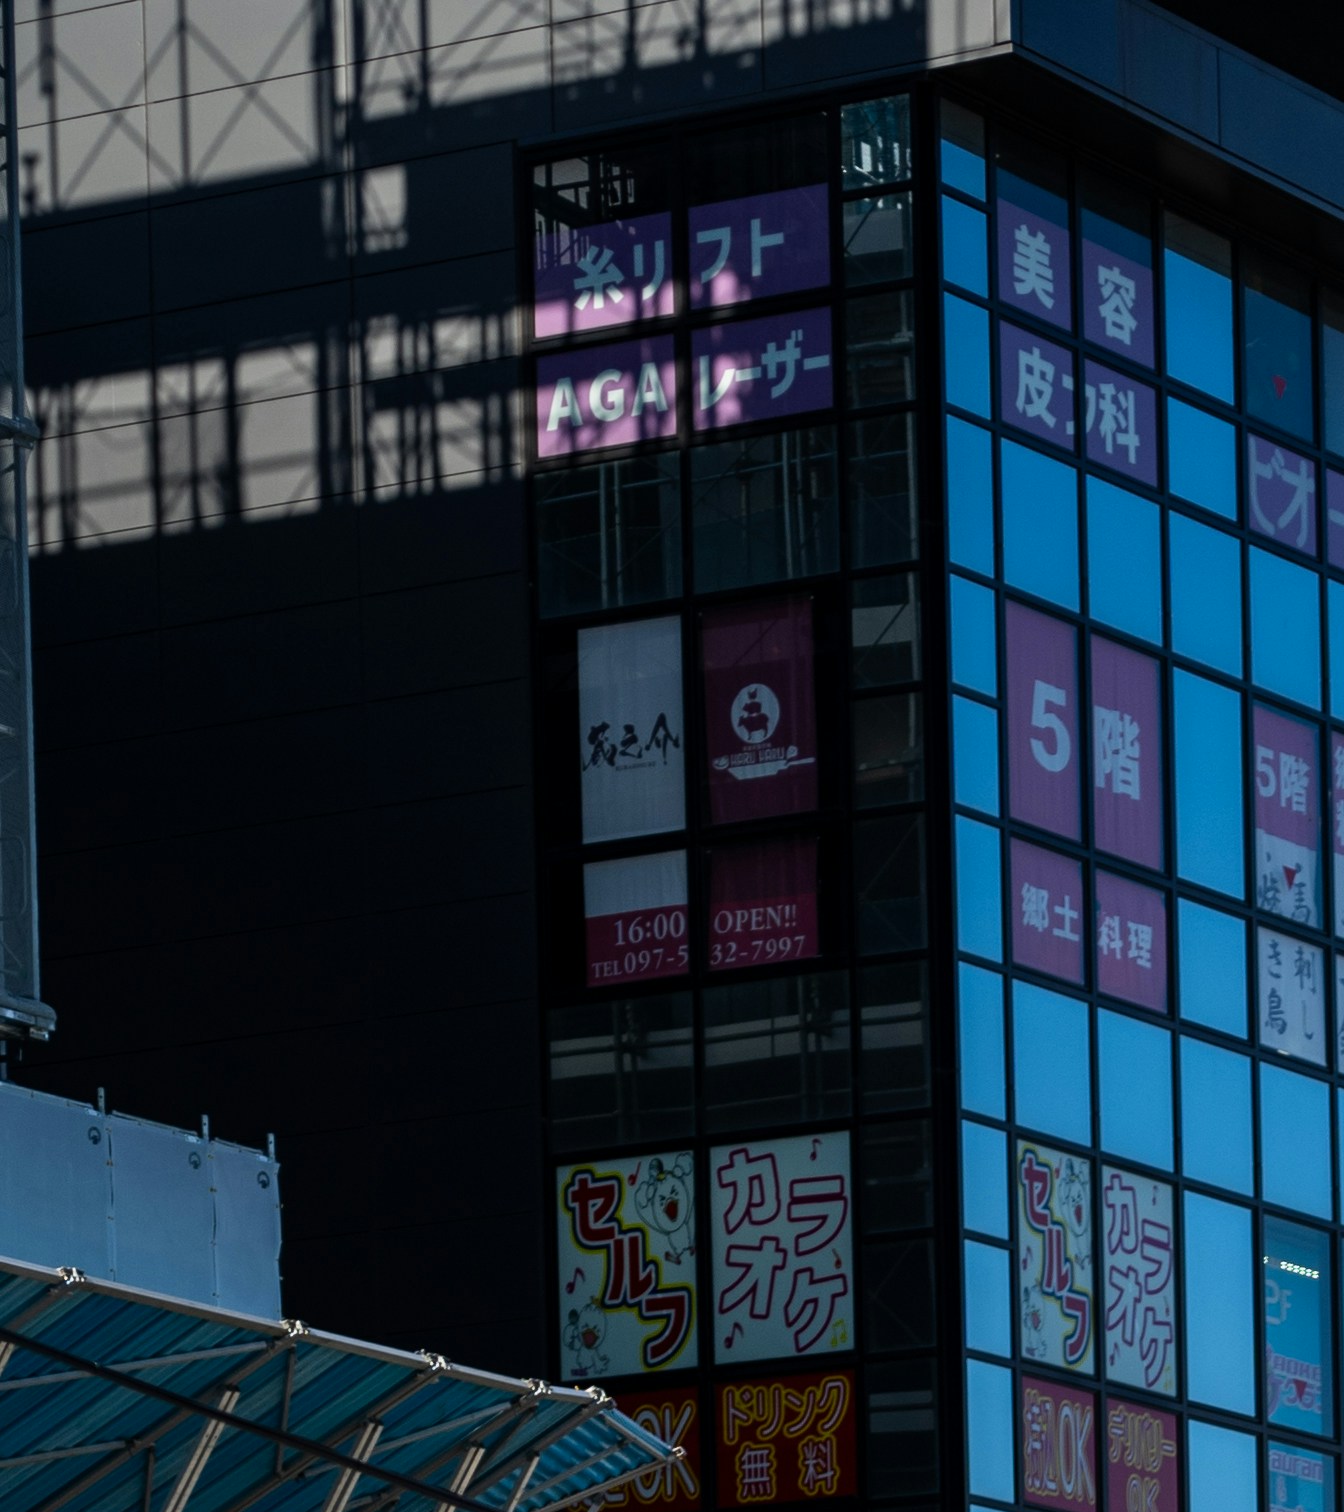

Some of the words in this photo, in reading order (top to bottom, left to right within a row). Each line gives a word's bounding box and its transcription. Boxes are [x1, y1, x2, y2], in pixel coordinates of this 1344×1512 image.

[574, 218, 785, 311] 糸リフト
[1014, 224, 1138, 345] 美容
[546, 362, 668, 432] AGA
[698, 329, 830, 411] レーザー
[1016, 346, 1140, 464] 皮フ科
[1029, 679, 1141, 800] 5階
[1255, 744, 1311, 814] 5階
[614, 911, 686, 946] 16:00
[1021, 882, 1154, 969] 郷土料理
[567, 1170, 692, 1367] セルフ
[717, 1148, 849, 1354] カラオケ
[1021, 1149, 1090, 1365] セルフ
[1104, 1174, 1173, 1388] カラオケ
[725, 1379, 848, 1442] ドリンク
[740, 1439, 836, 1499] 無料
